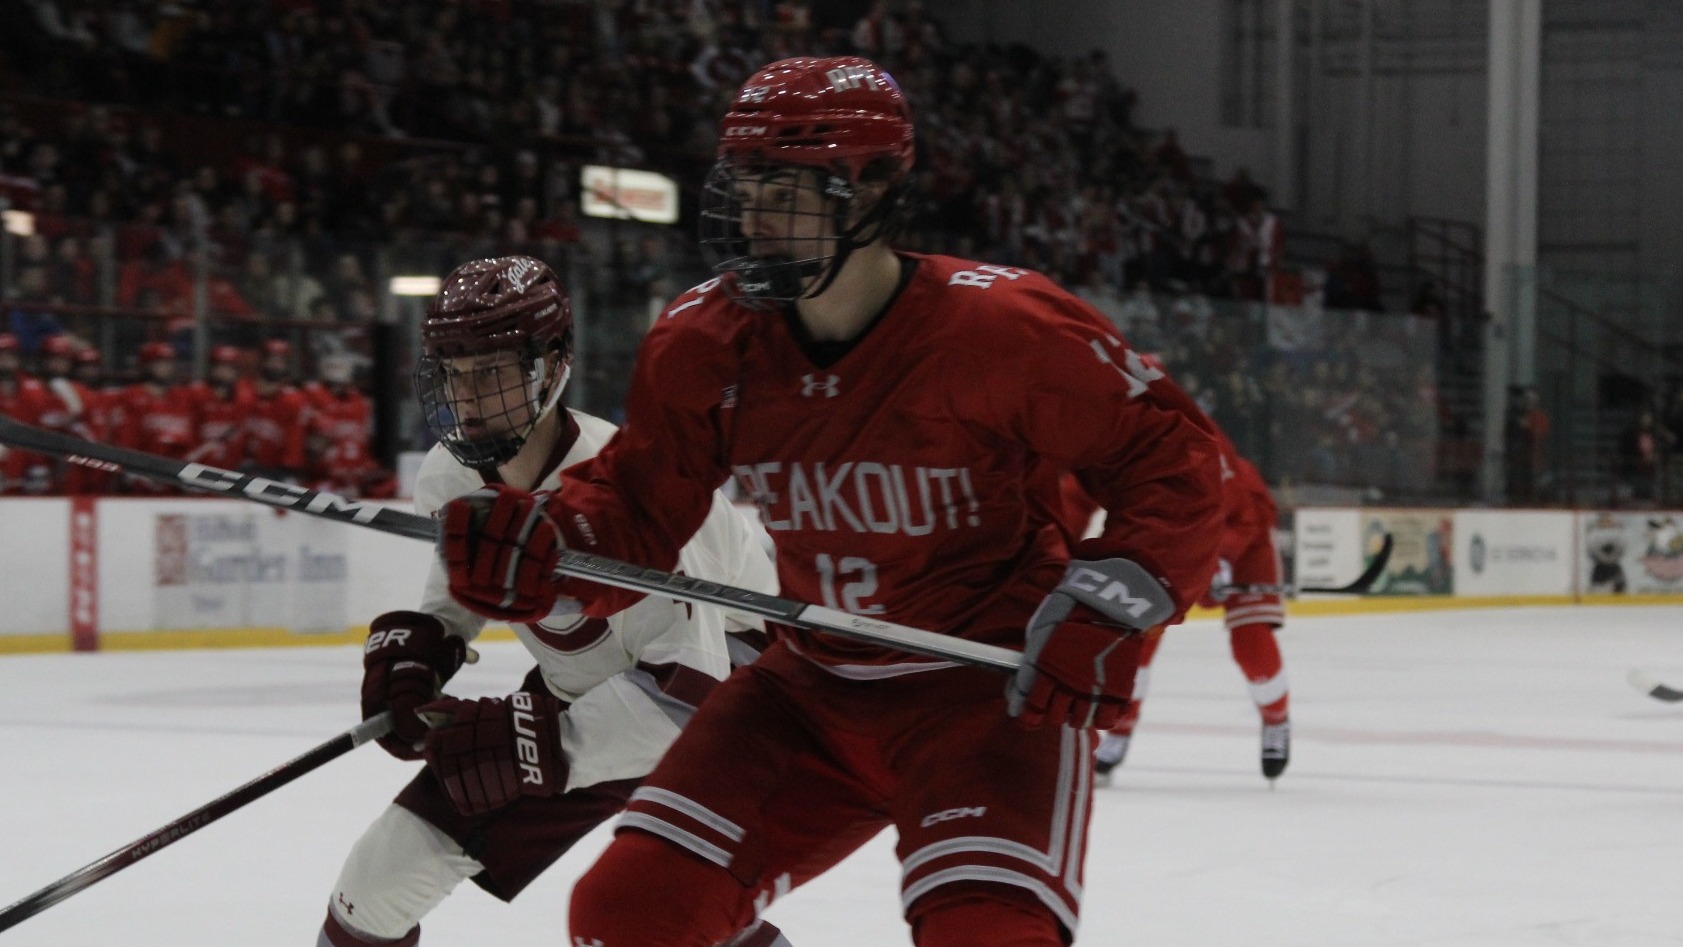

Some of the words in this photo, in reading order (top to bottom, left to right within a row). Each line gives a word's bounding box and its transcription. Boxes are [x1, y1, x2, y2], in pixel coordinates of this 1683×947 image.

[725, 126, 768, 137] CCM
[177, 461, 384, 525] CCM
[815, 553, 887, 614] 12
[1065, 567, 1154, 618] CM
[511, 691, 544, 786] AUER
[919, 806, 988, 829] CCM
